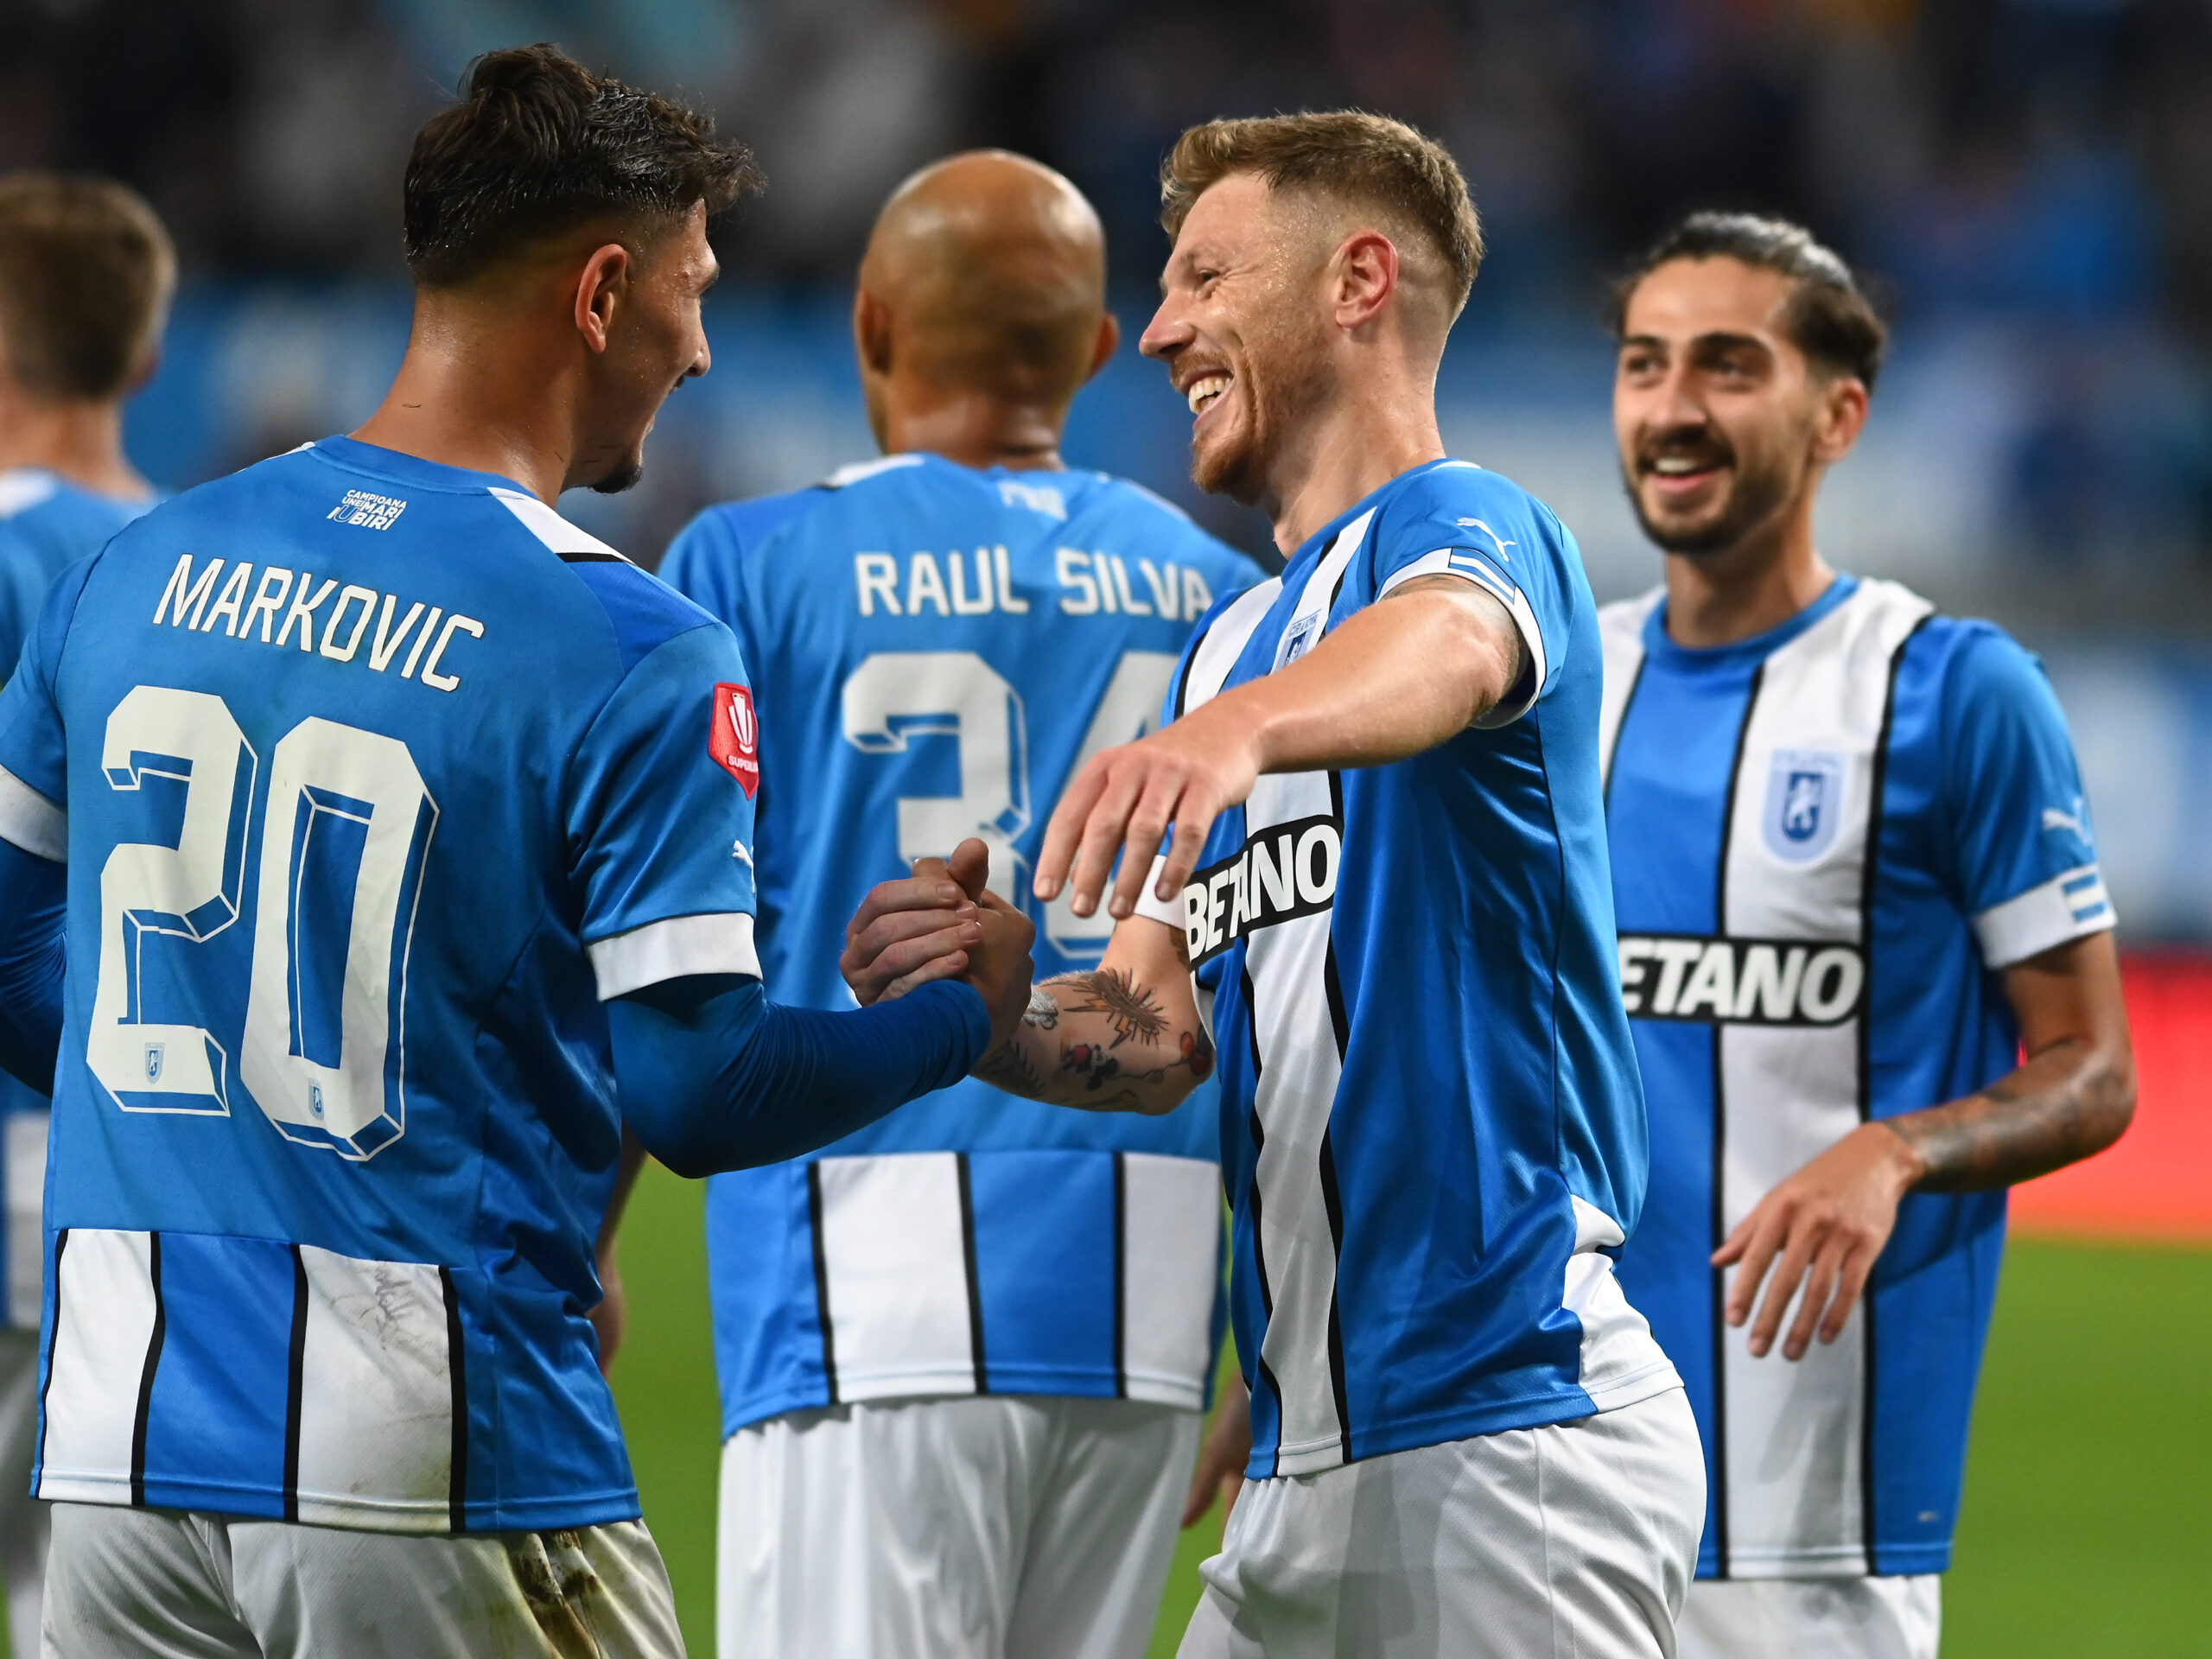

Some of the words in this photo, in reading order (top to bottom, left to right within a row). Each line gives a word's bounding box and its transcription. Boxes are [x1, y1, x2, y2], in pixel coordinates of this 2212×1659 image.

[346, 489, 407, 510] CAMPIOANA
[359, 501, 404, 519] MARI
[152, 553, 485, 692] MARKOVIC
[855, 544, 1029, 617] RAUL
[1055, 546, 1214, 623] SILVA
[86, 684, 440, 1161] 20
[1183, 823, 1341, 963] BETANO
[1617, 936, 1866, 1023] ETANO
